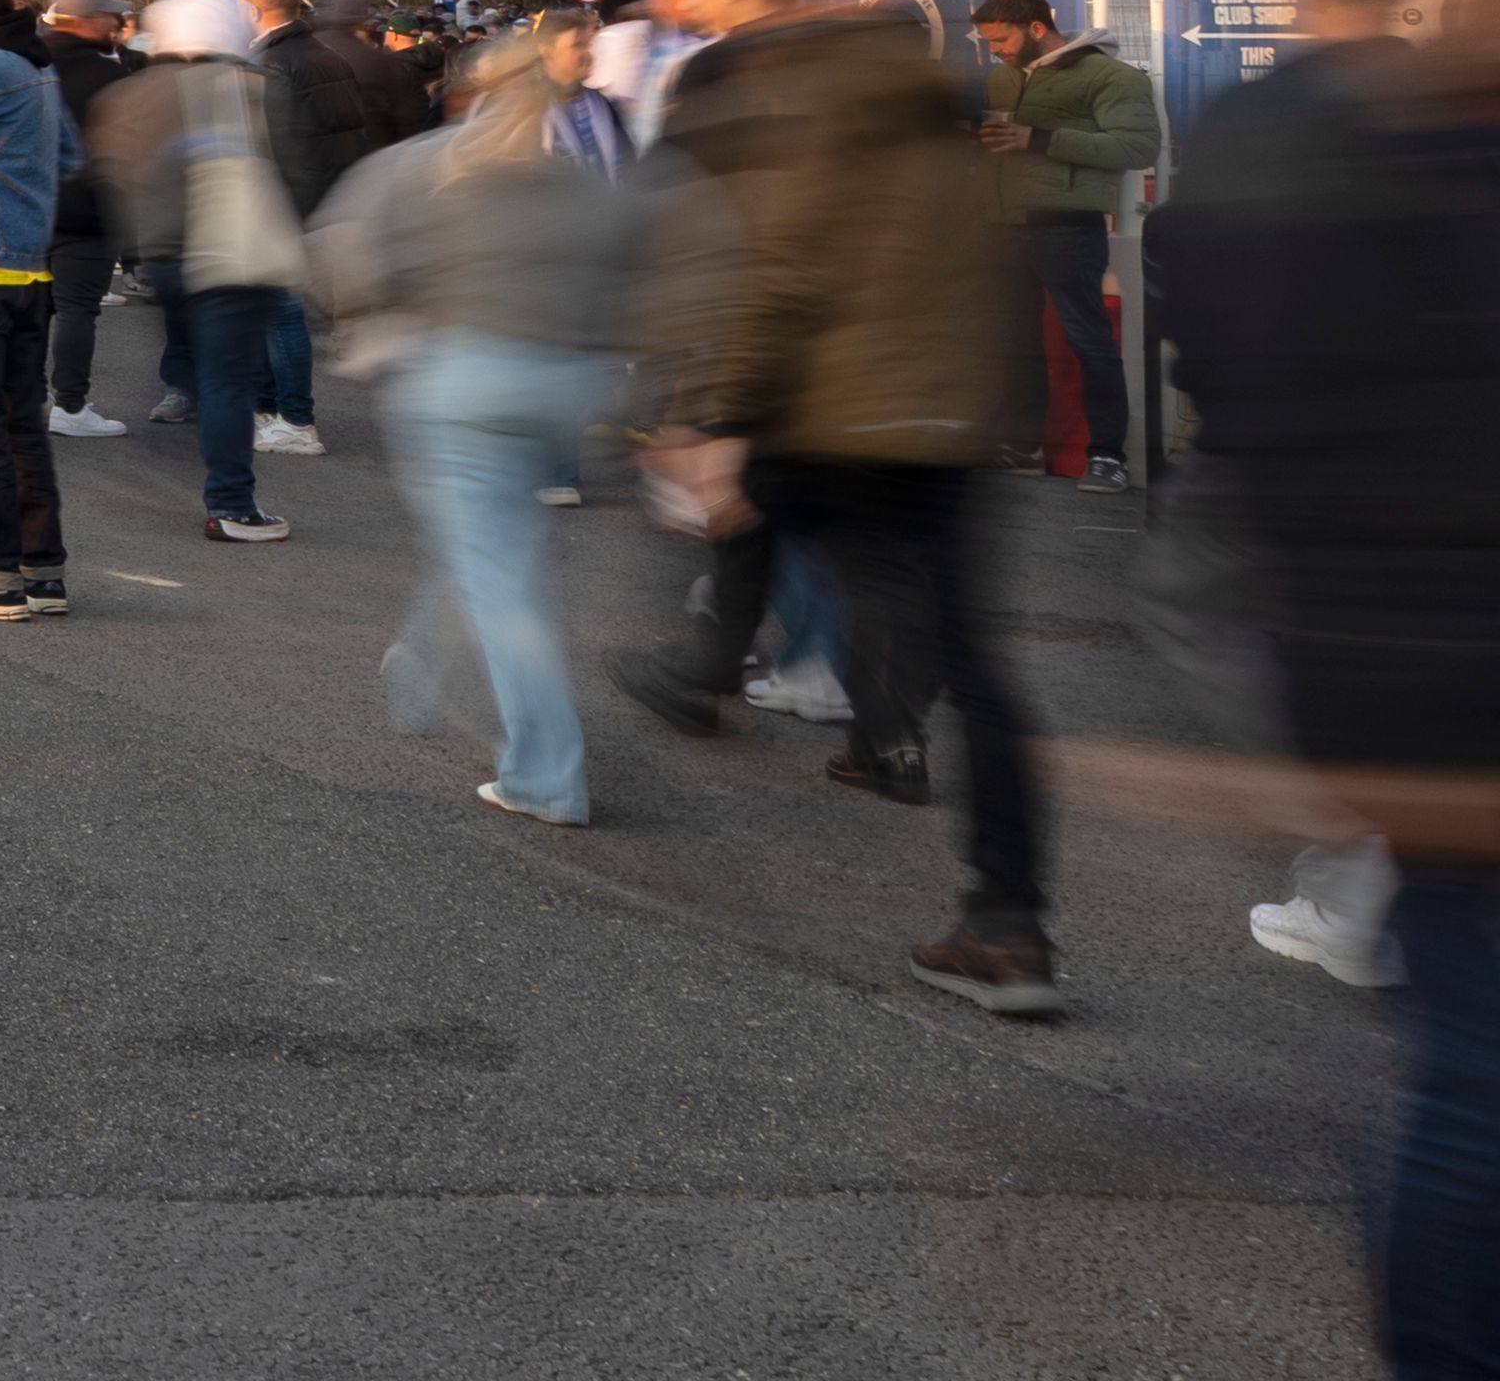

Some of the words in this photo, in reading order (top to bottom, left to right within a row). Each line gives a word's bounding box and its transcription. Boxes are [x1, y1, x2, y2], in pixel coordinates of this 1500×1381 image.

[1214, 5, 1252, 25] CLUB
[1253, 5, 1297, 25] SHOP
[1240, 46, 1275, 66] THIS
